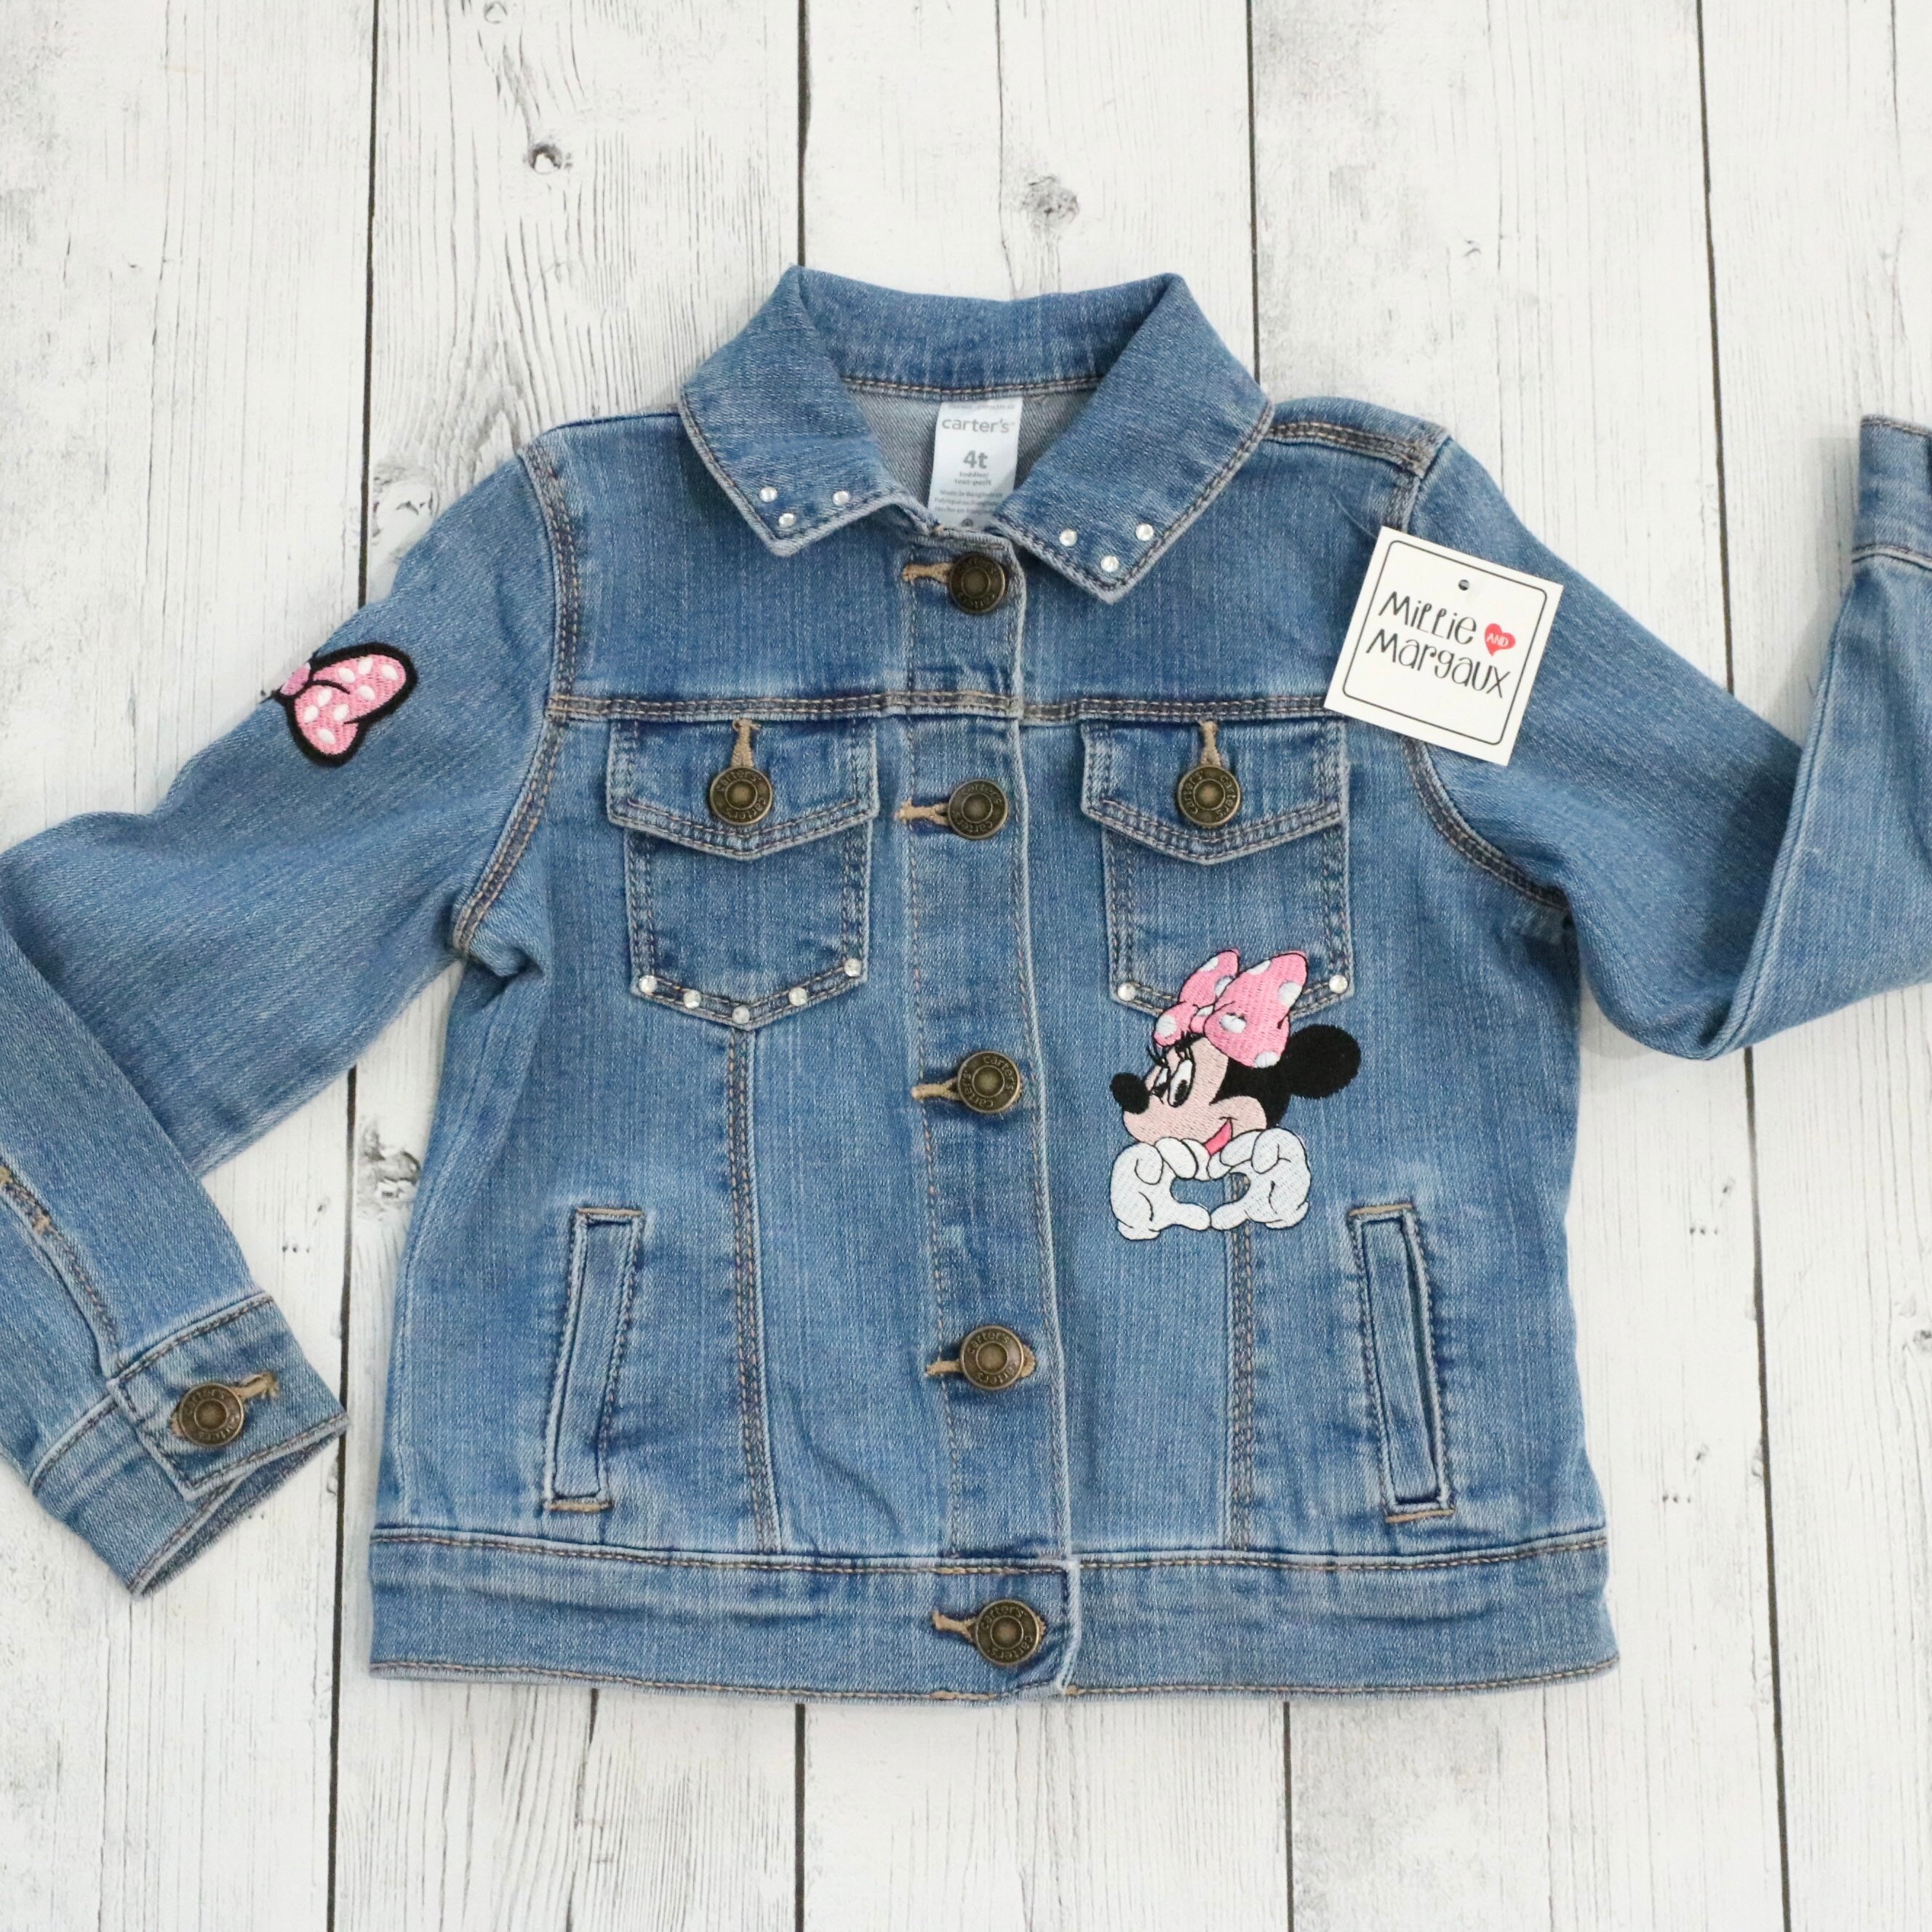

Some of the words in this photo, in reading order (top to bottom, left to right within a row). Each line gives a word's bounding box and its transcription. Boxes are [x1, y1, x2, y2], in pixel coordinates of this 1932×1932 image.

[941, 418, 1010, 434] carter's
[963, 450, 989, 469] 4t
[1378, 591, 1477, 644] Millie
[1486, 632, 1509, 647] AND
[1365, 628, 1512, 698] Margaux
